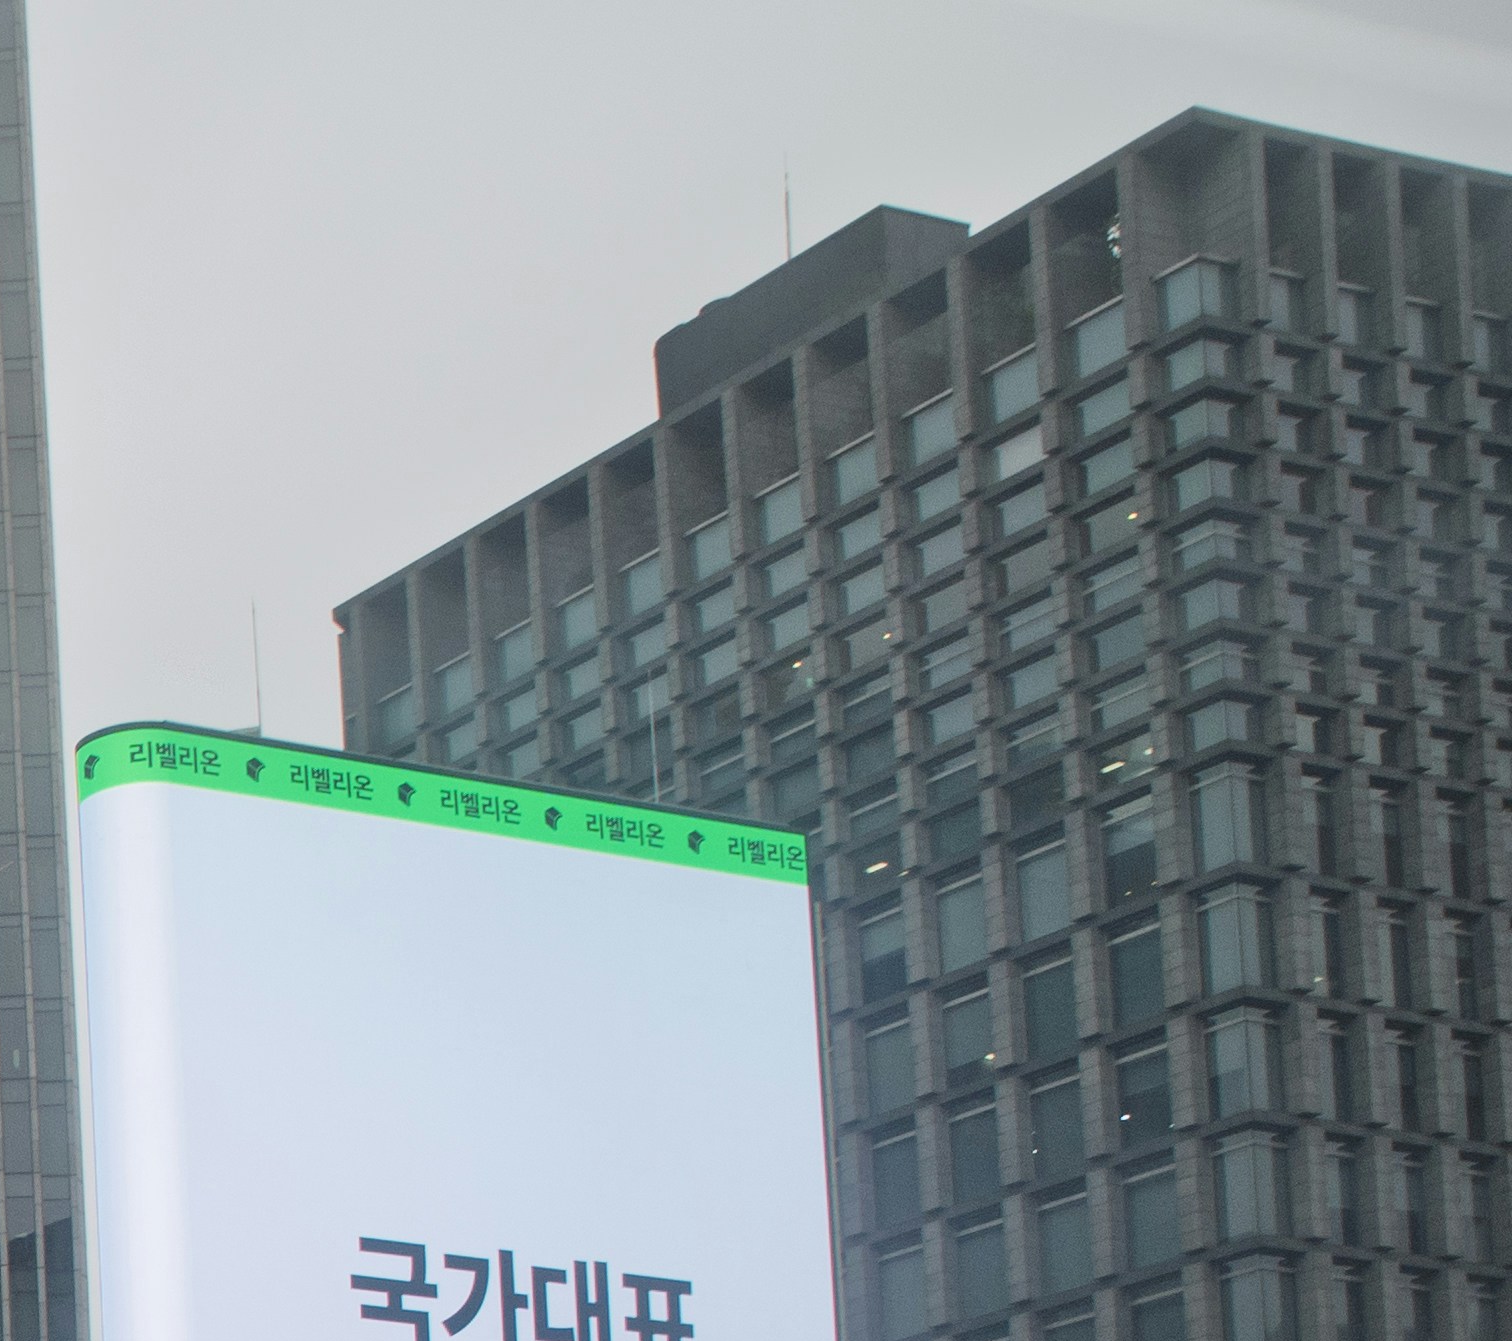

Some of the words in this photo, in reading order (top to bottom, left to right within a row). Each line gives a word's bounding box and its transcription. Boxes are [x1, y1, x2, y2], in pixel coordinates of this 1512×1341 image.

[129, 740, 222, 779] 리벨리온
[290, 763, 374, 801] 리벨리온
[439, 787, 522, 826] 리벨리온
[585, 811, 665, 849] 리벨리온
[728, 834, 806, 873] 리벨리온
